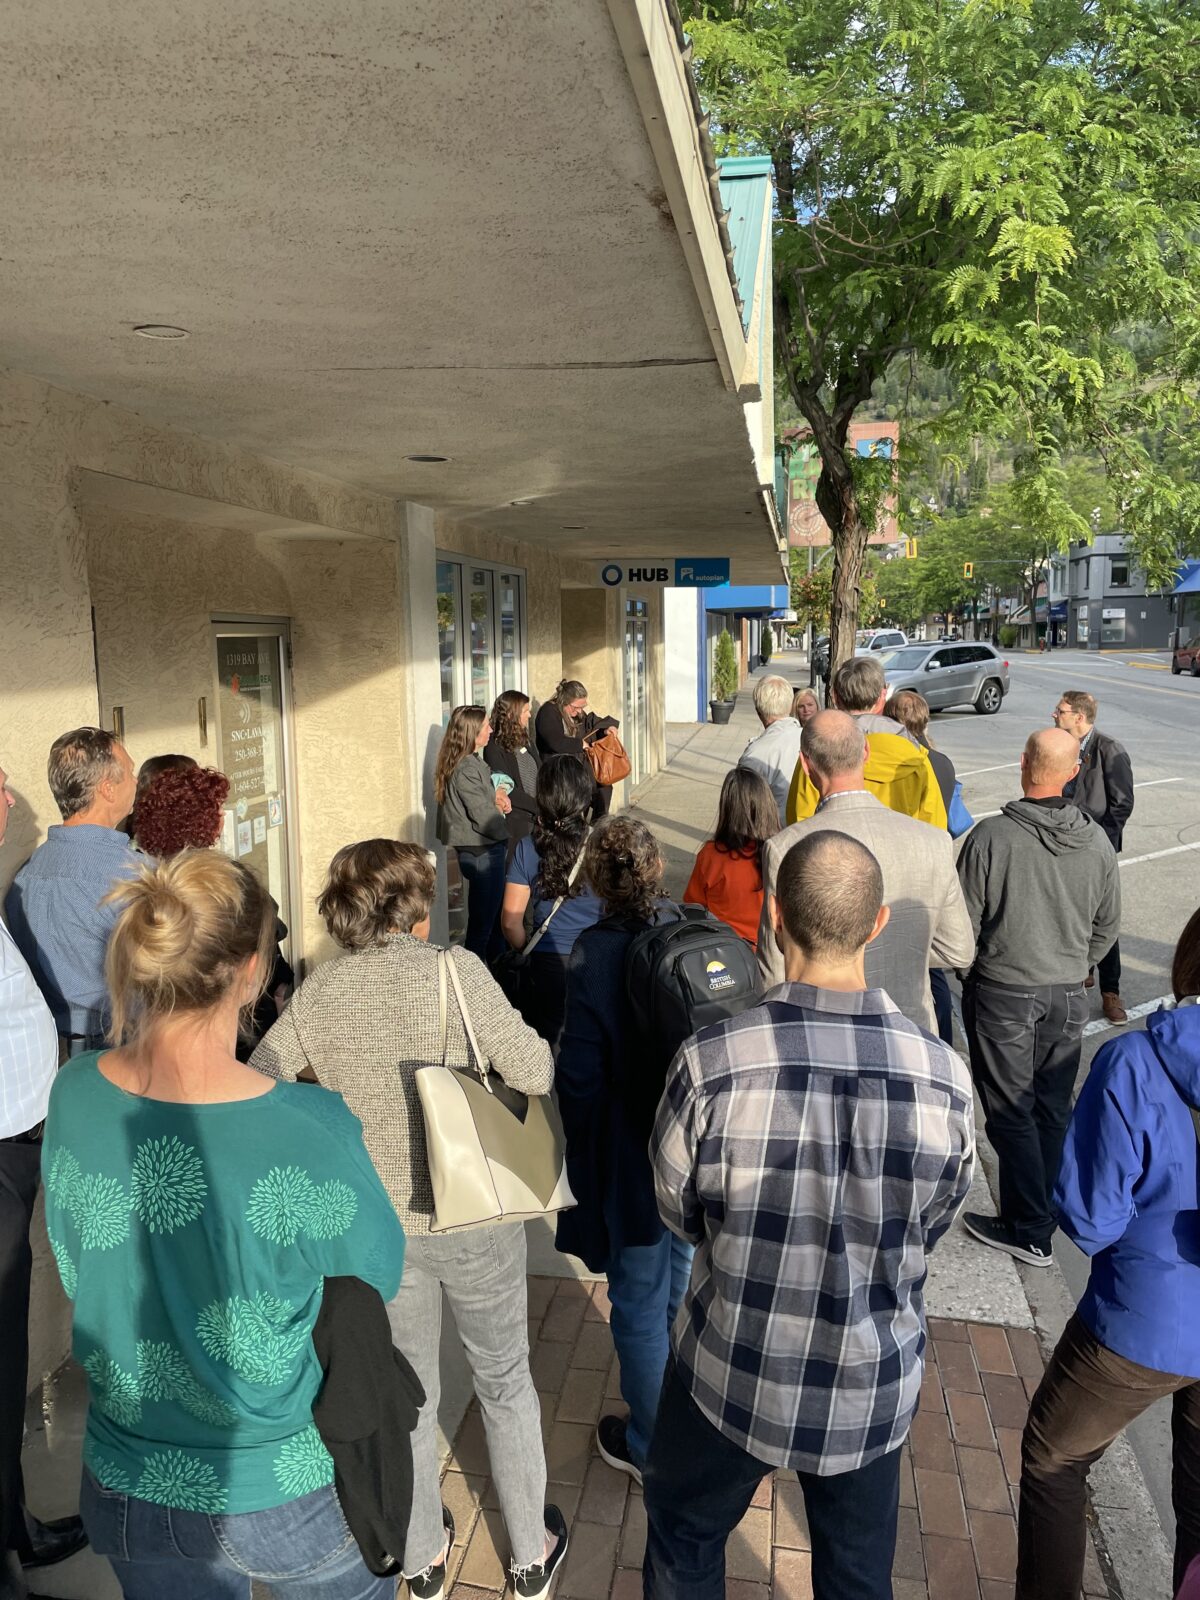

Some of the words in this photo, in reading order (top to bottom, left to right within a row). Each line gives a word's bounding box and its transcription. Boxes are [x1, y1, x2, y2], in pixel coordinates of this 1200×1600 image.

[628, 568, 669, 582] HUB
[695, 574, 724, 582] autoplan
[226, 653, 241, 666] 1319
[242, 653, 257, 665] BAY
[709, 979, 736, 990] COLUMBIA
